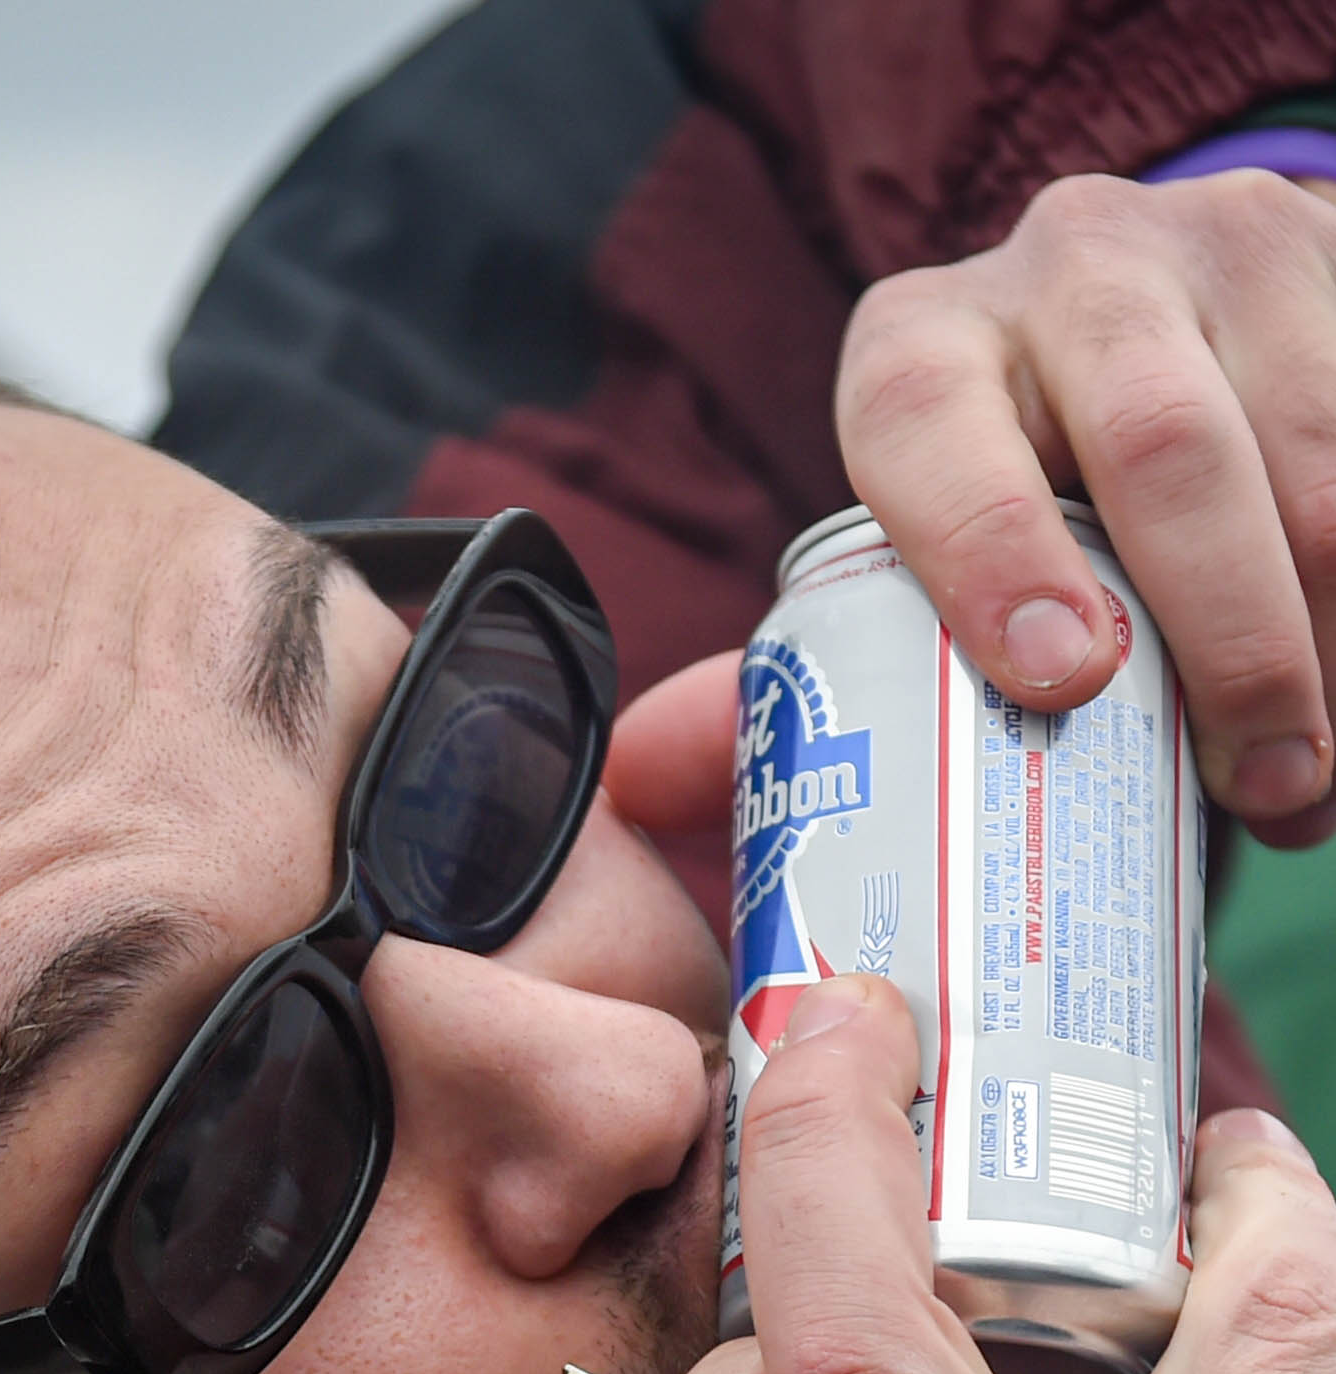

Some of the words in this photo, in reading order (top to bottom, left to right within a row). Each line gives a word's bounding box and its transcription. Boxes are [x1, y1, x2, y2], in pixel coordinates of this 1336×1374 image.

[983, 738, 1000, 754] WI
[1054, 748, 1070, 768] THE
[1092, 728, 1107, 750] THE
[1004, 756, 1021, 798] PLEASE
[1054, 774, 1070, 788] TO
[1092, 756, 1107, 772] OF
[1073, 770, 1088, 806] DRINK
[1092, 778, 1107, 834] BECAUSE
[1004, 816, 1021, 868] ALC/VOL
[1054, 794, 1070, 866] ACCORDING
[1073, 820, 1088, 844] NOT
[1110, 800, 1124, 890] CONSUMPTION
[1025, 750, 1042, 964] WWW.PABSTBLUERIBBON.COM
[1092, 840, 1107, 914] PREGNANCY
[1073, 858, 1088, 906] SHOULD
[1143, 900, 1154, 930] AND
[983, 924, 1000, 982] BREWING
[1073, 920, 1088, 970] WOMEN
[1092, 922, 1107, 968] DURING
[1127, 926, 1140, 978] IMPAIRS
[983, 992, 1000, 1032] PABST
[1054, 954, 1070, 1040] GOVERNMENT
[1092, 976, 1107, 1046] BEVERAGES
[1110, 990, 1124, 1026] BIRTH
[1127, 984, 1140, 1056] BEVERAGES
[1004, 1016, 1021, 1030] 12
